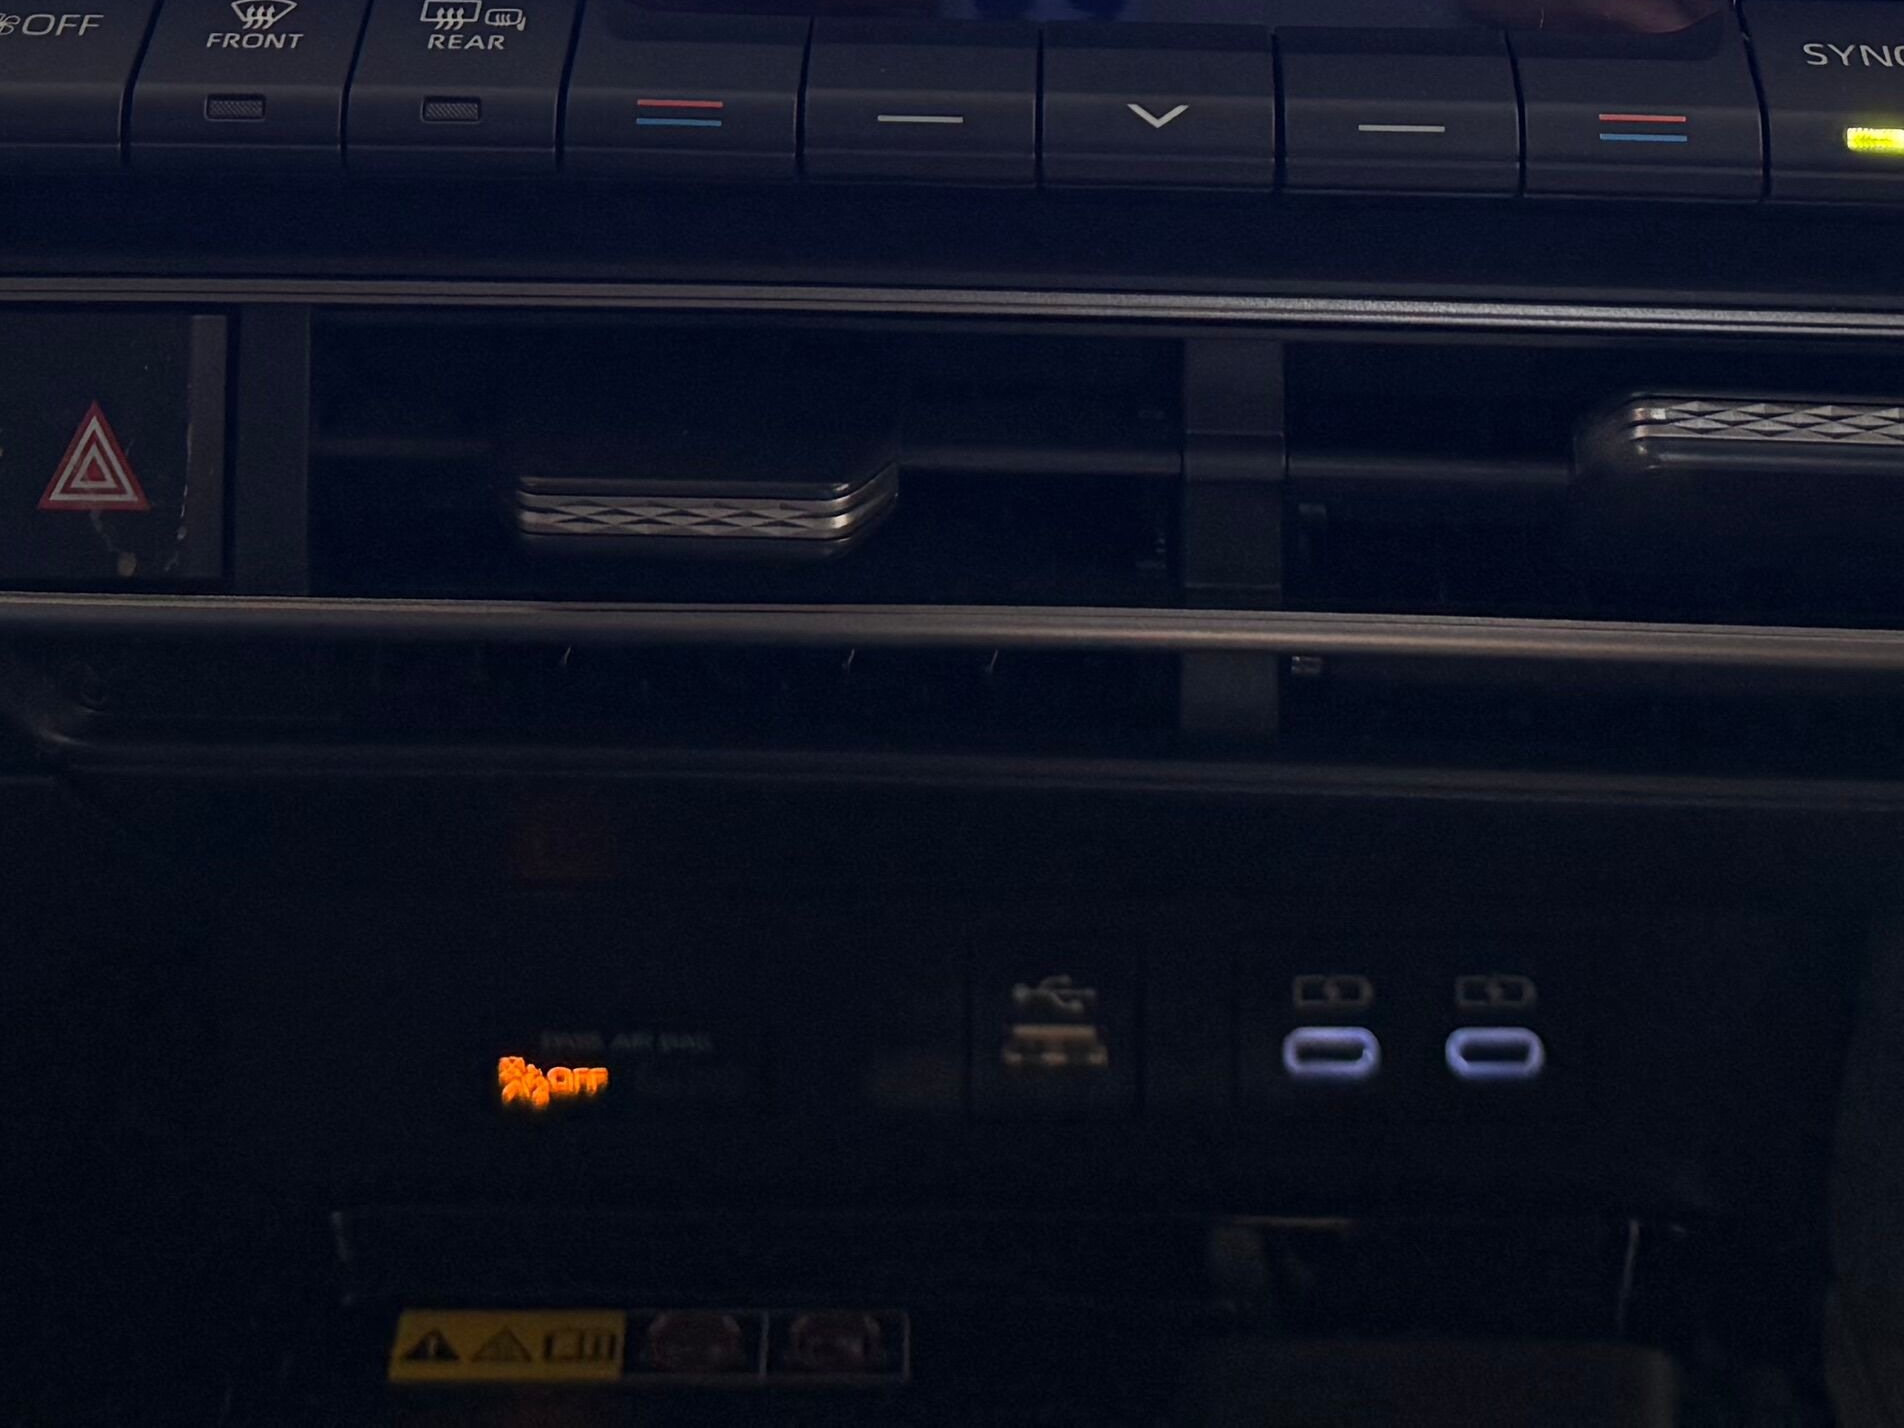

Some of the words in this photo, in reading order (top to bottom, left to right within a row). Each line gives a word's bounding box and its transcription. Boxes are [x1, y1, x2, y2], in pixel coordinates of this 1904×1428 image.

[21, 13, 105, 37] OFF
[206, 32, 304, 50] FRONT
[427, 33, 506, 51] REAR
